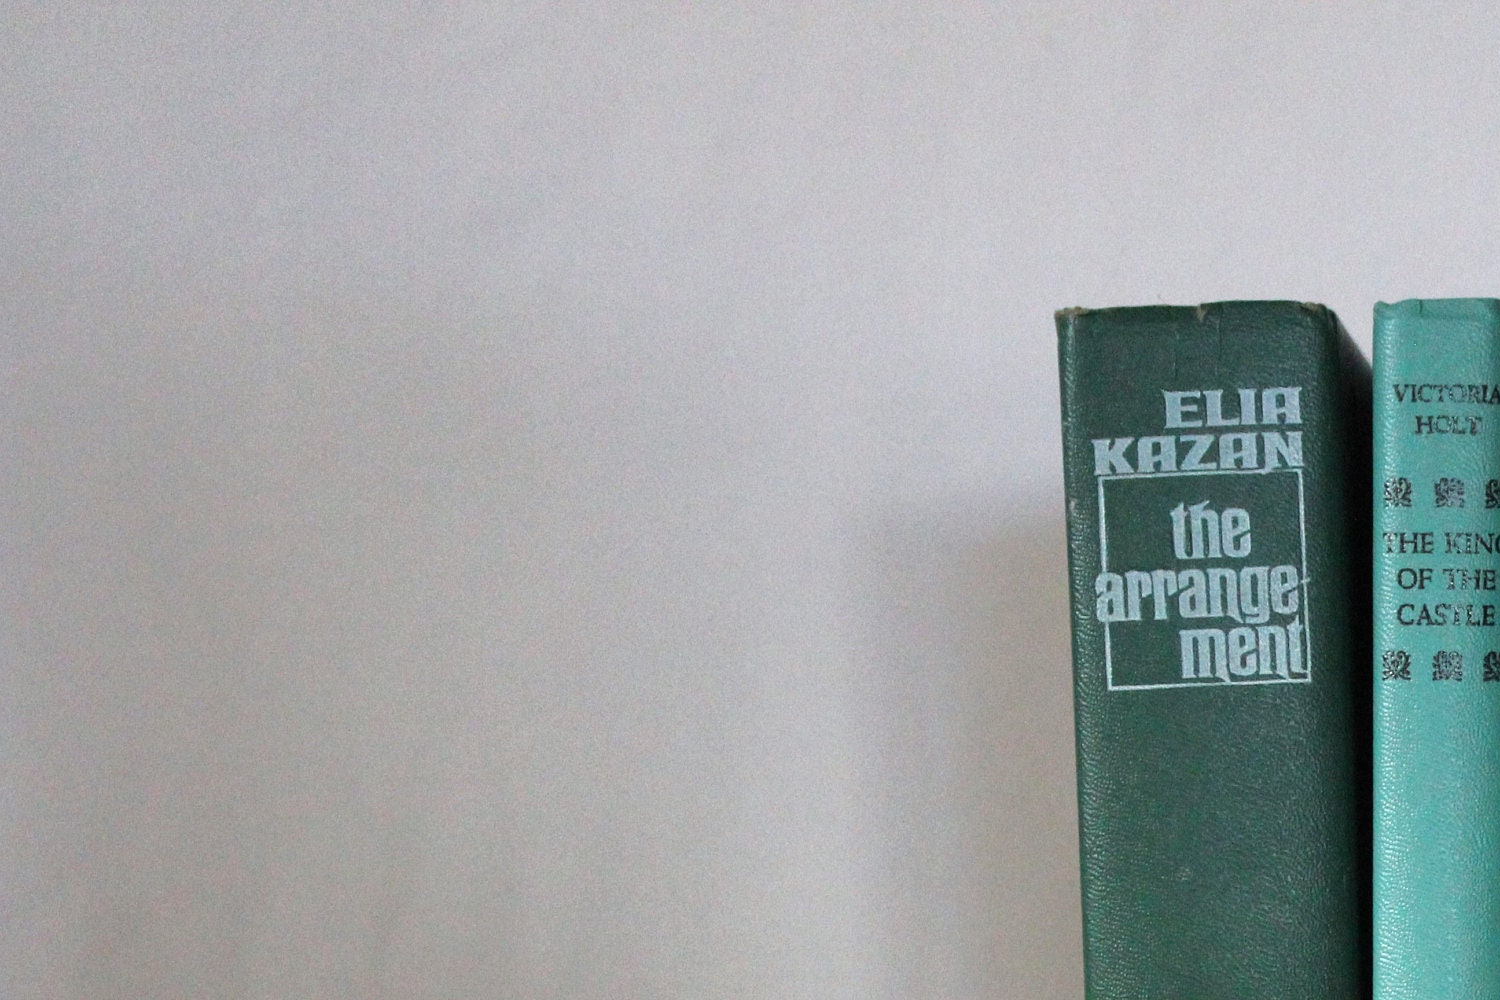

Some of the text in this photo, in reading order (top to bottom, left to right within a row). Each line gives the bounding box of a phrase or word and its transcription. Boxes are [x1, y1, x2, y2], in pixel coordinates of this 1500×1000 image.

[1161, 387, 1302, 429] ELIA
[1415, 415, 1482, 435] HOLT
[1092, 431, 1304, 475] KAZAN
[1170, 500, 1252, 560] the
[1382, 532, 1434, 555] THE
[1397, 569, 1496, 591] OF THE
[1396, 604, 1496, 626] CASTLE
[1179, 614, 1310, 682] ment
